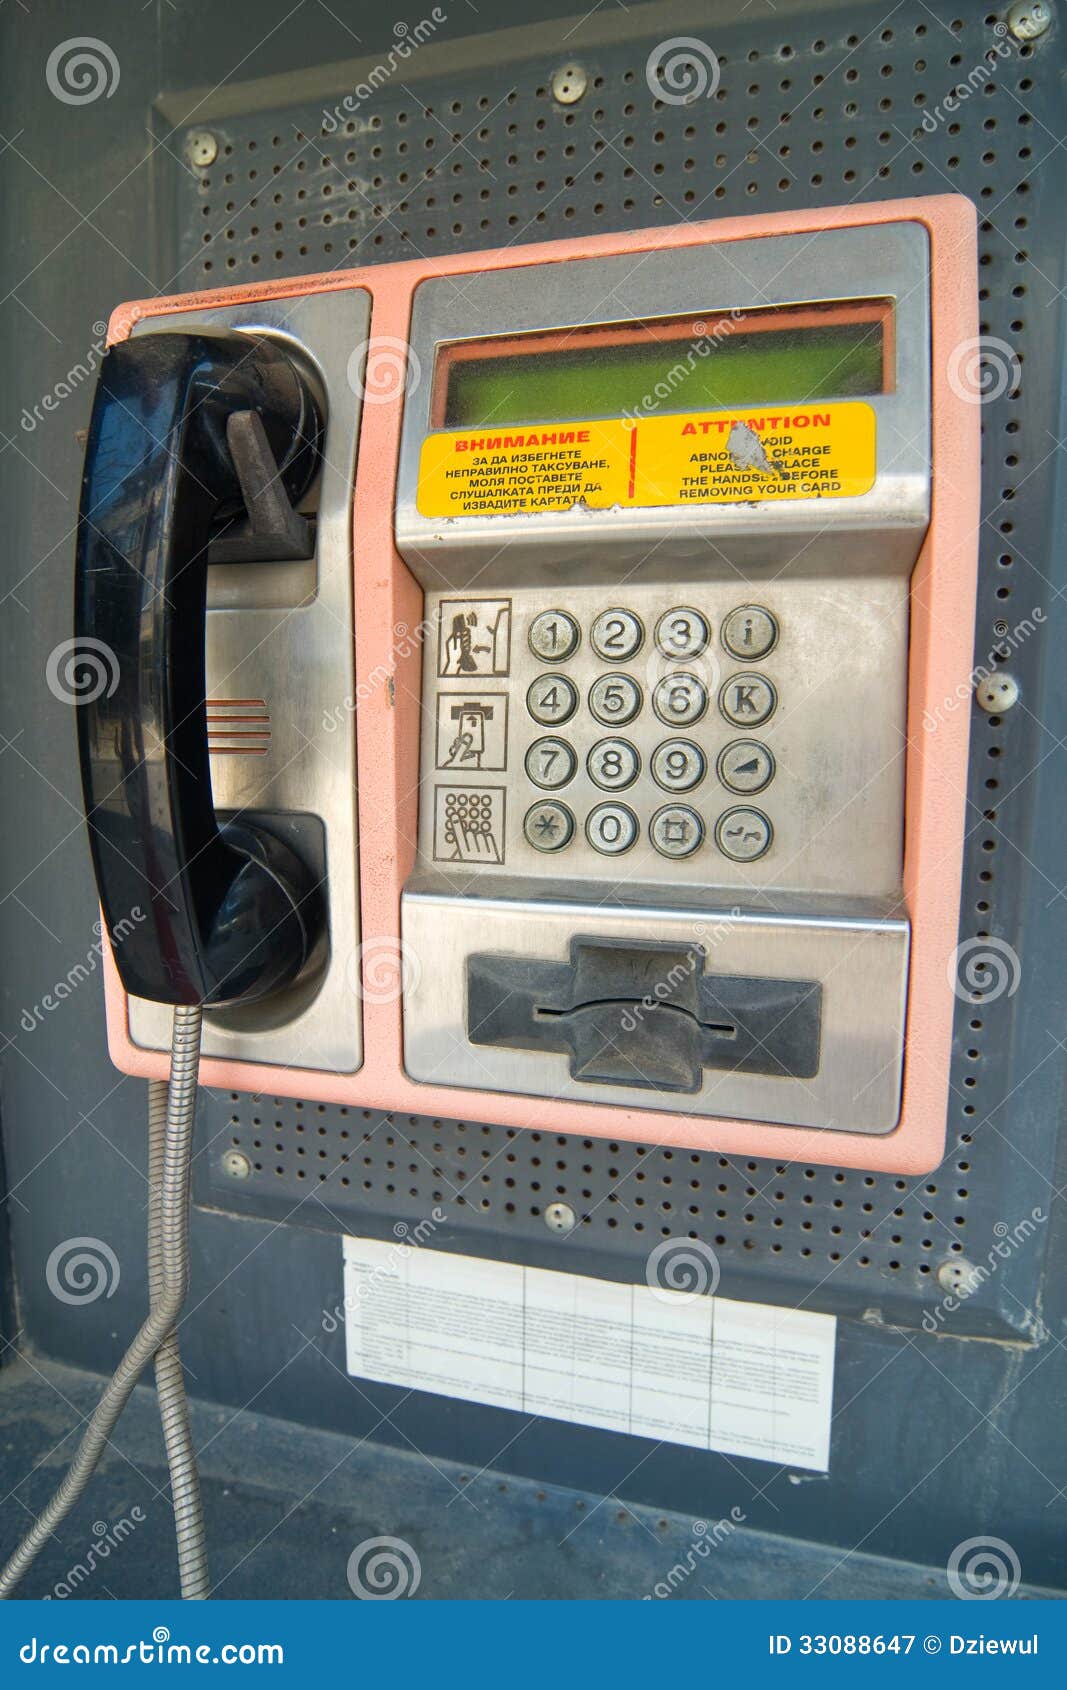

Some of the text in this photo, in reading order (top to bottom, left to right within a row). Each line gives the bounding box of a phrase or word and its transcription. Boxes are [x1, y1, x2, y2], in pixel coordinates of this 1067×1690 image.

[455, 430, 591, 453] ВНИМАНИЕ
[472, 450, 582, 466] ЗА ДА ИЗБЕГНЕТЕ
[772, 445, 832, 459] CHARGE
[445, 459, 611, 479] НЕПРАВИЛНО ТАКСУВАНЕ,
[469, 472, 583, 488] МОЛЯ ПОСТАВЕТЕ
[682, 476, 709, 486] THE
[450, 483, 602, 500] СЛУШАЛКАТА ПРЕДИ ДА
[679, 481, 842, 499] REMOVING YOUR CARD
[463, 495, 588, 511] ИЗВАДИТЕ КАРТАТА
[547, 621, 559, 650] 1
[603, 619, 626, 649] 2
[669, 618, 692, 649] 3
[539, 684, 760, 715] 4 5 6 K
[540, 749, 689, 780] 7 8 9
[600, 815, 622, 843] 0
